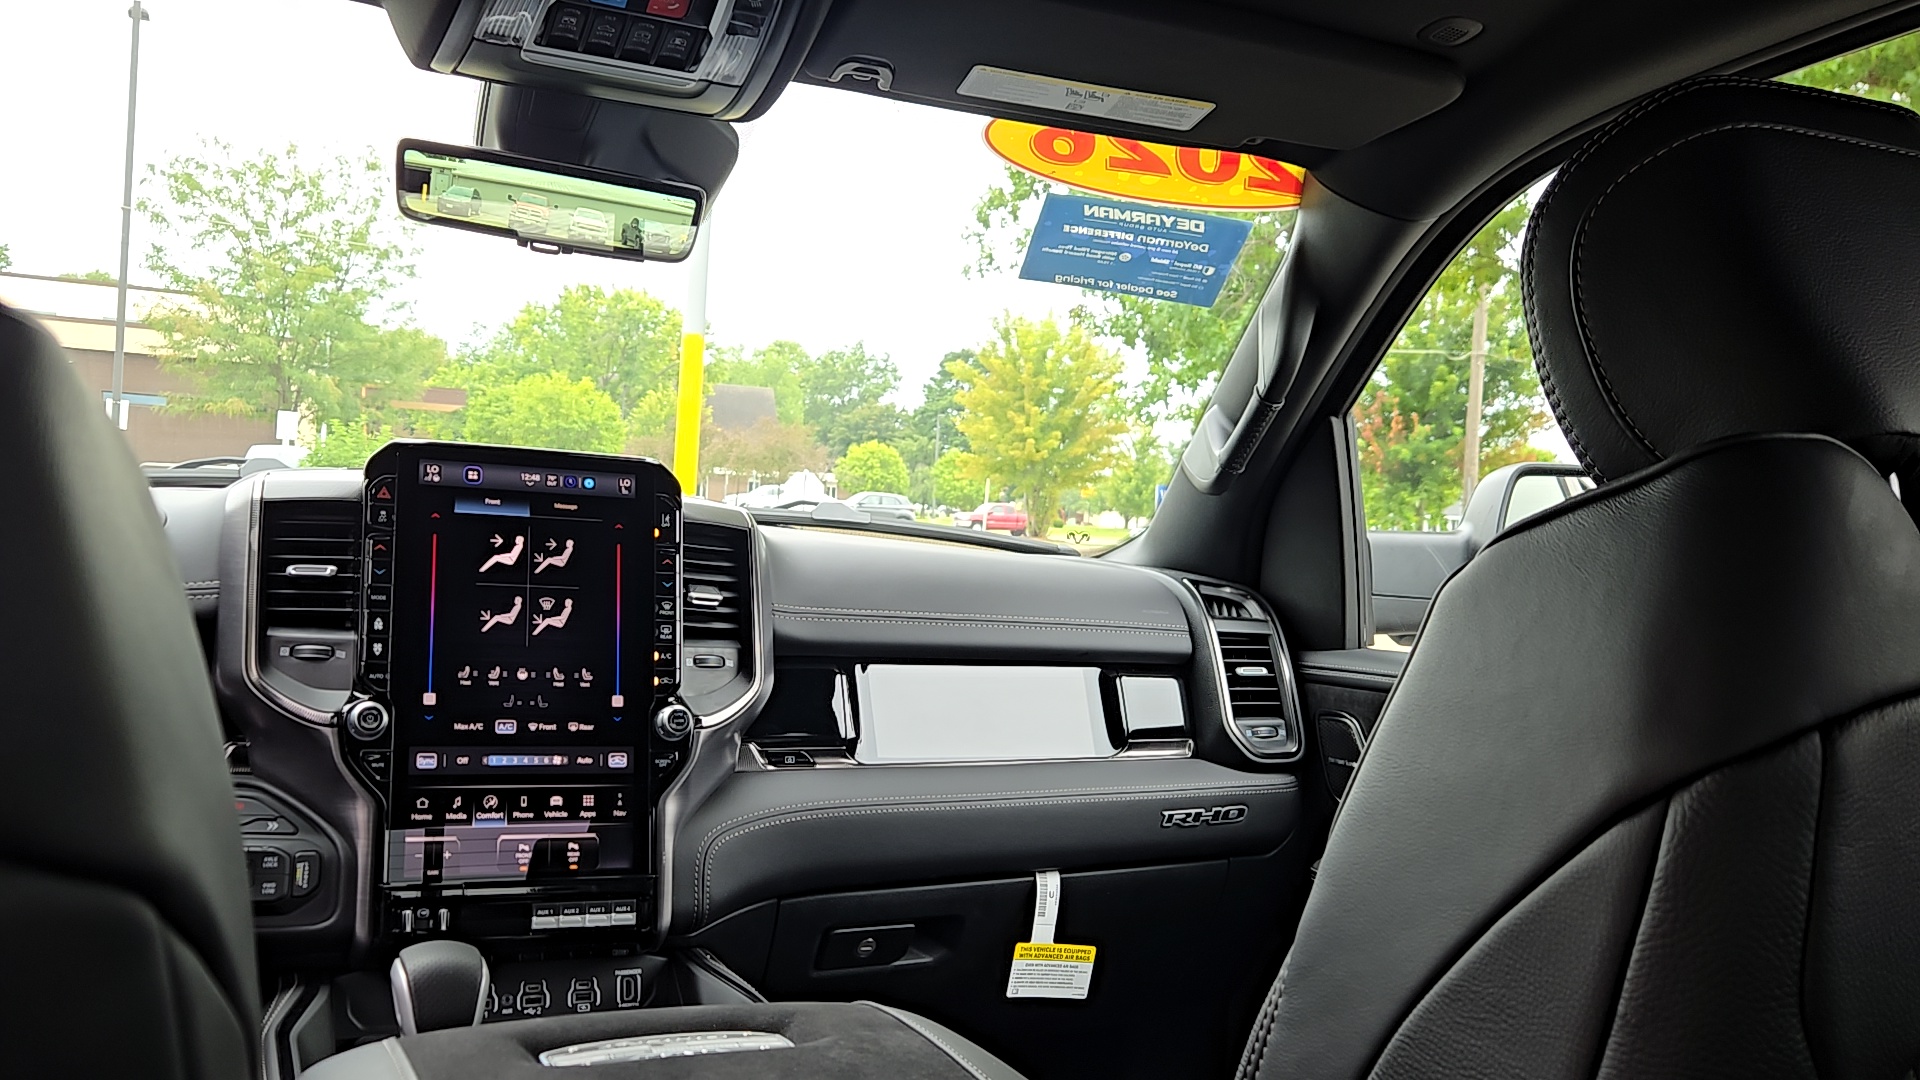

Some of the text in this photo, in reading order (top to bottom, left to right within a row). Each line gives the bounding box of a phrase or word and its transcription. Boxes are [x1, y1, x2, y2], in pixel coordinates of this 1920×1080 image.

[426, 464, 440, 474] LO
[521, 473, 541, 482] 12:48
[619, 479, 632, 487] LO
[469, 722, 484, 730] A/C
[539, 723, 557, 731] Front
[579, 723, 594, 731] Rear
[456, 756, 469, 765] Off
[576, 757, 593, 765] Auto
[445, 812, 467, 820] Media
[476, 811, 504, 820] Comfort
[513, 811, 534, 819] Phone
[579, 810, 596, 818] Apps
[1161, 805, 1248, 827] RHO
